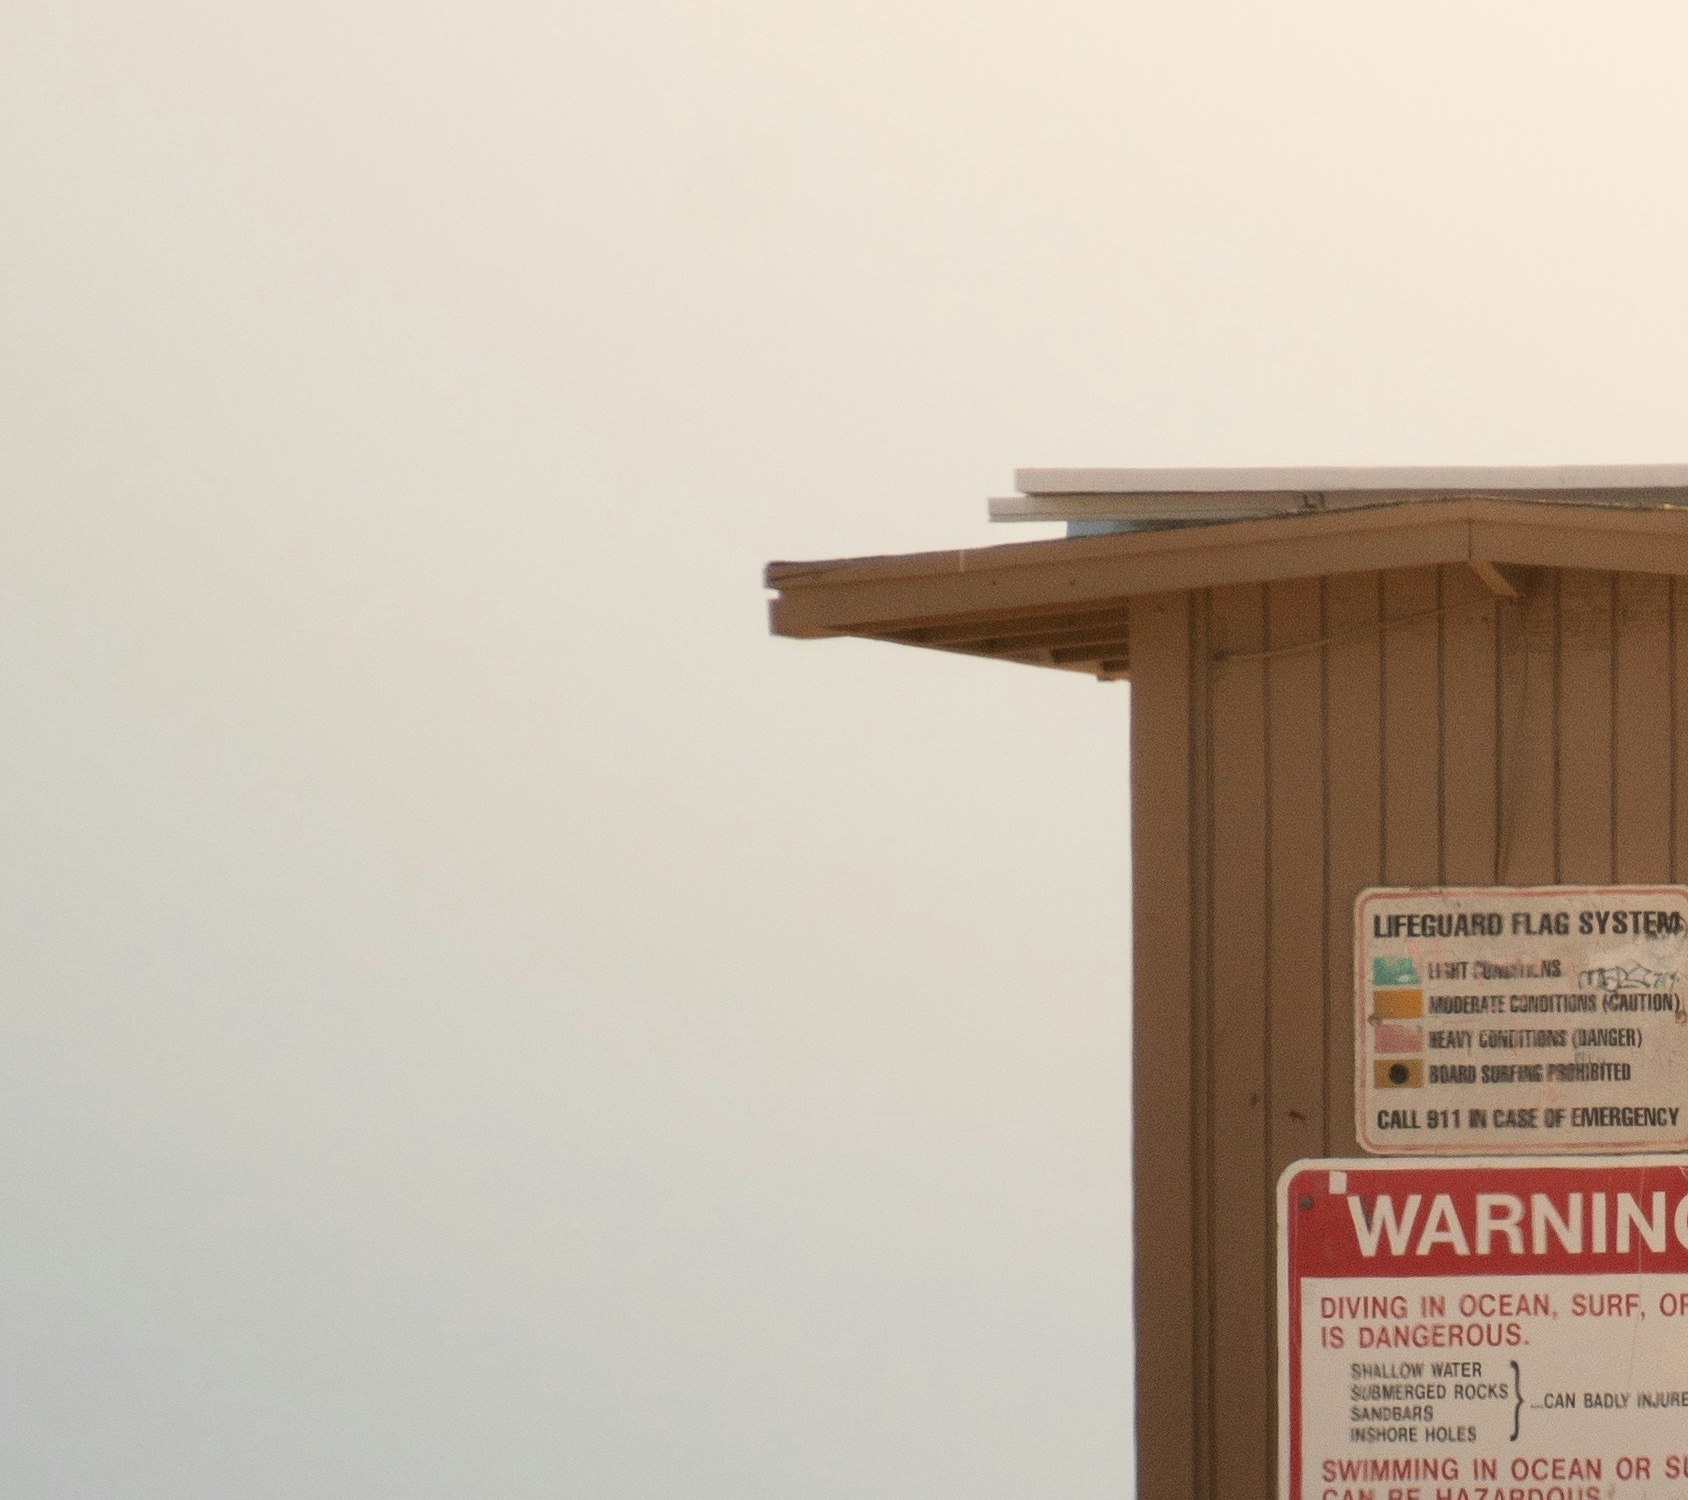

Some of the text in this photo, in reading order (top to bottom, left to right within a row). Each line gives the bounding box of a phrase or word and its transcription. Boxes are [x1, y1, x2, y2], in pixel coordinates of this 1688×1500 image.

[1374, 911, 1681, 938] LIFEGUARD FLAG SYSTEM
[1510, 994, 1597, 1013] CONDITIONS
[1429, 1064, 1477, 1084] BOARD
[1377, 1107, 1679, 1130] CALL 911 IN CASE OF EMERGENCY
[1321, 1296, 1407, 1319] DIVING
[1421, 1296, 1445, 1318] IN
[1459, 1294, 1557, 1317] OCEAN,
[1572, 1293, 1645, 1319] SURF,
[1321, 1323, 1528, 1349] IS DANGEROUS.
[1351, 1362, 1481, 1380] SHALLOW WATER
[1351, 1383, 1508, 1401] SUBMERGED ROCKS
[1584, 1393, 1629, 1409] BADLY
[1351, 1405, 1433, 1422] SANDBARS
[1350, 1426, 1476, 1443] INSHORE HOLES
[1323, 1458, 1458, 1482] SWIMMING
[1473, 1459, 1497, 1481] IN
[1511, 1458, 1601, 1481] OCEAN
[1616, 1457, 1650, 1481] OR
